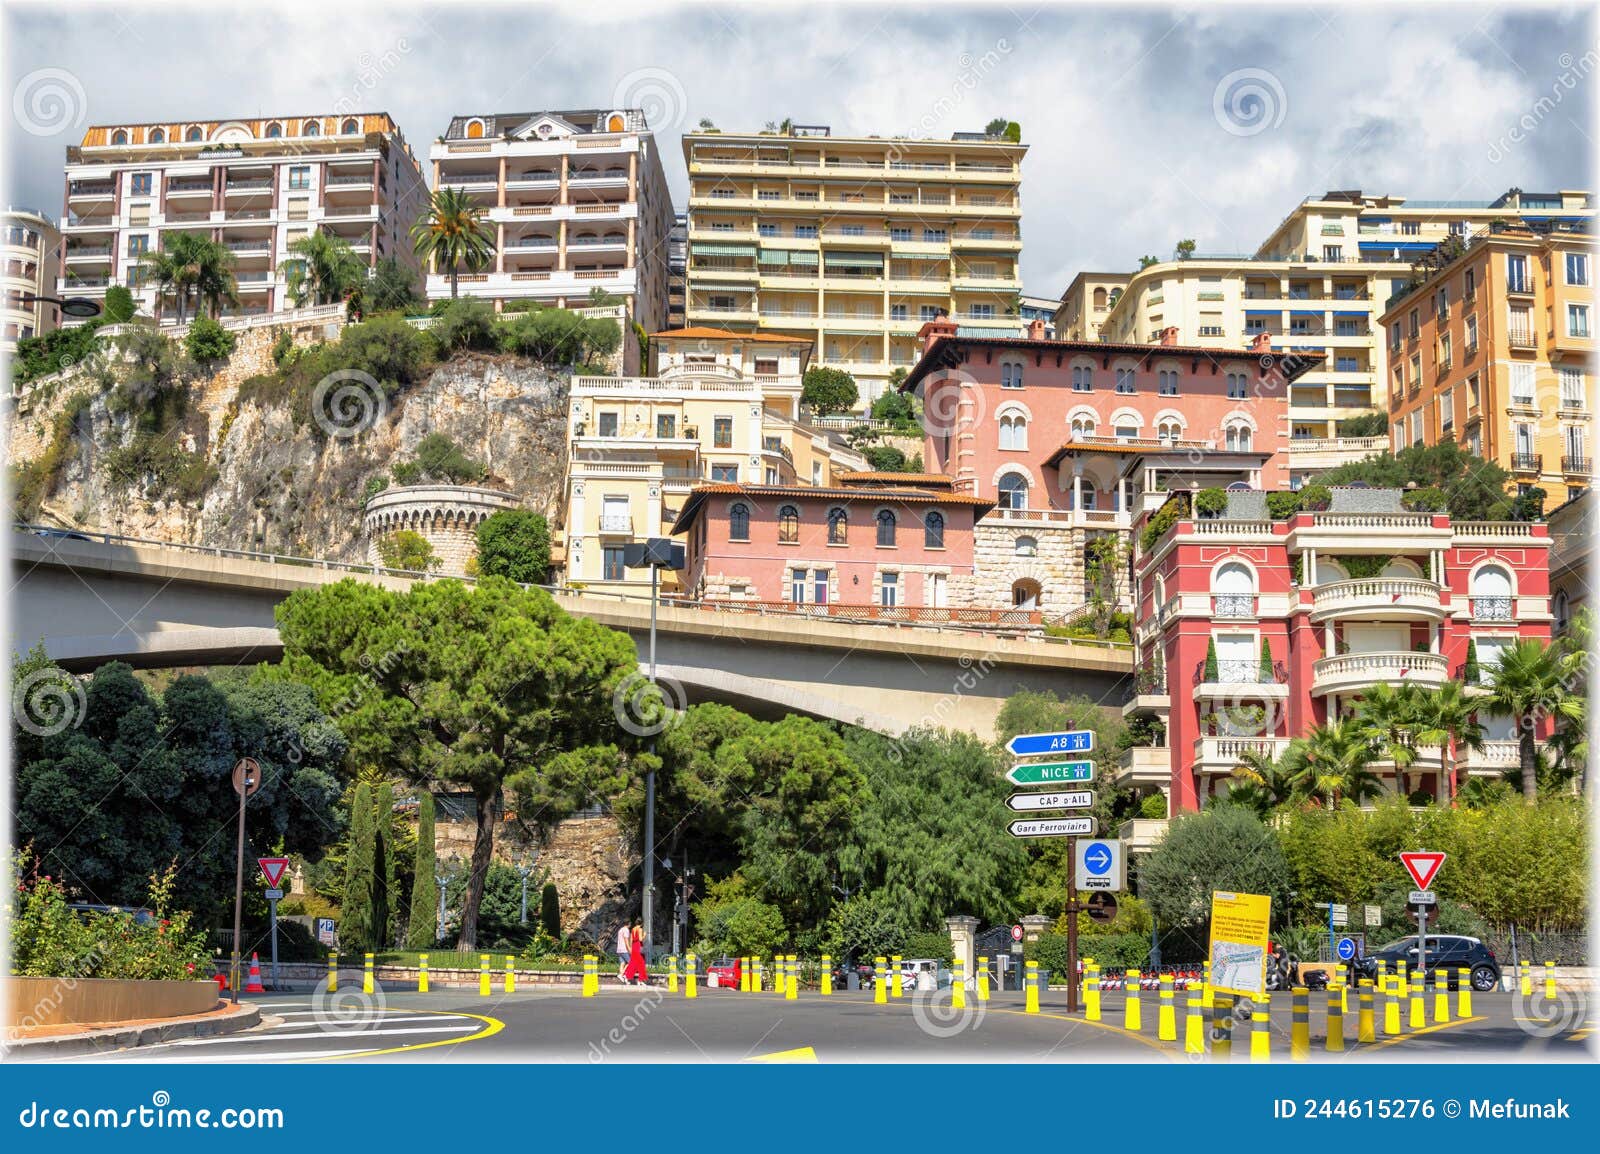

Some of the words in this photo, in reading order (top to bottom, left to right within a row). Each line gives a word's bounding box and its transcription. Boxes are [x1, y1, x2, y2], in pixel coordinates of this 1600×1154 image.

[1050, 737, 1068, 749] A8
[1041, 767, 1069, 778] NICE
[1039, 796, 1059, 806] CAP
[1016, 824, 1037, 833] Gare
[1039, 822, 1088, 832] Ferroviaire
